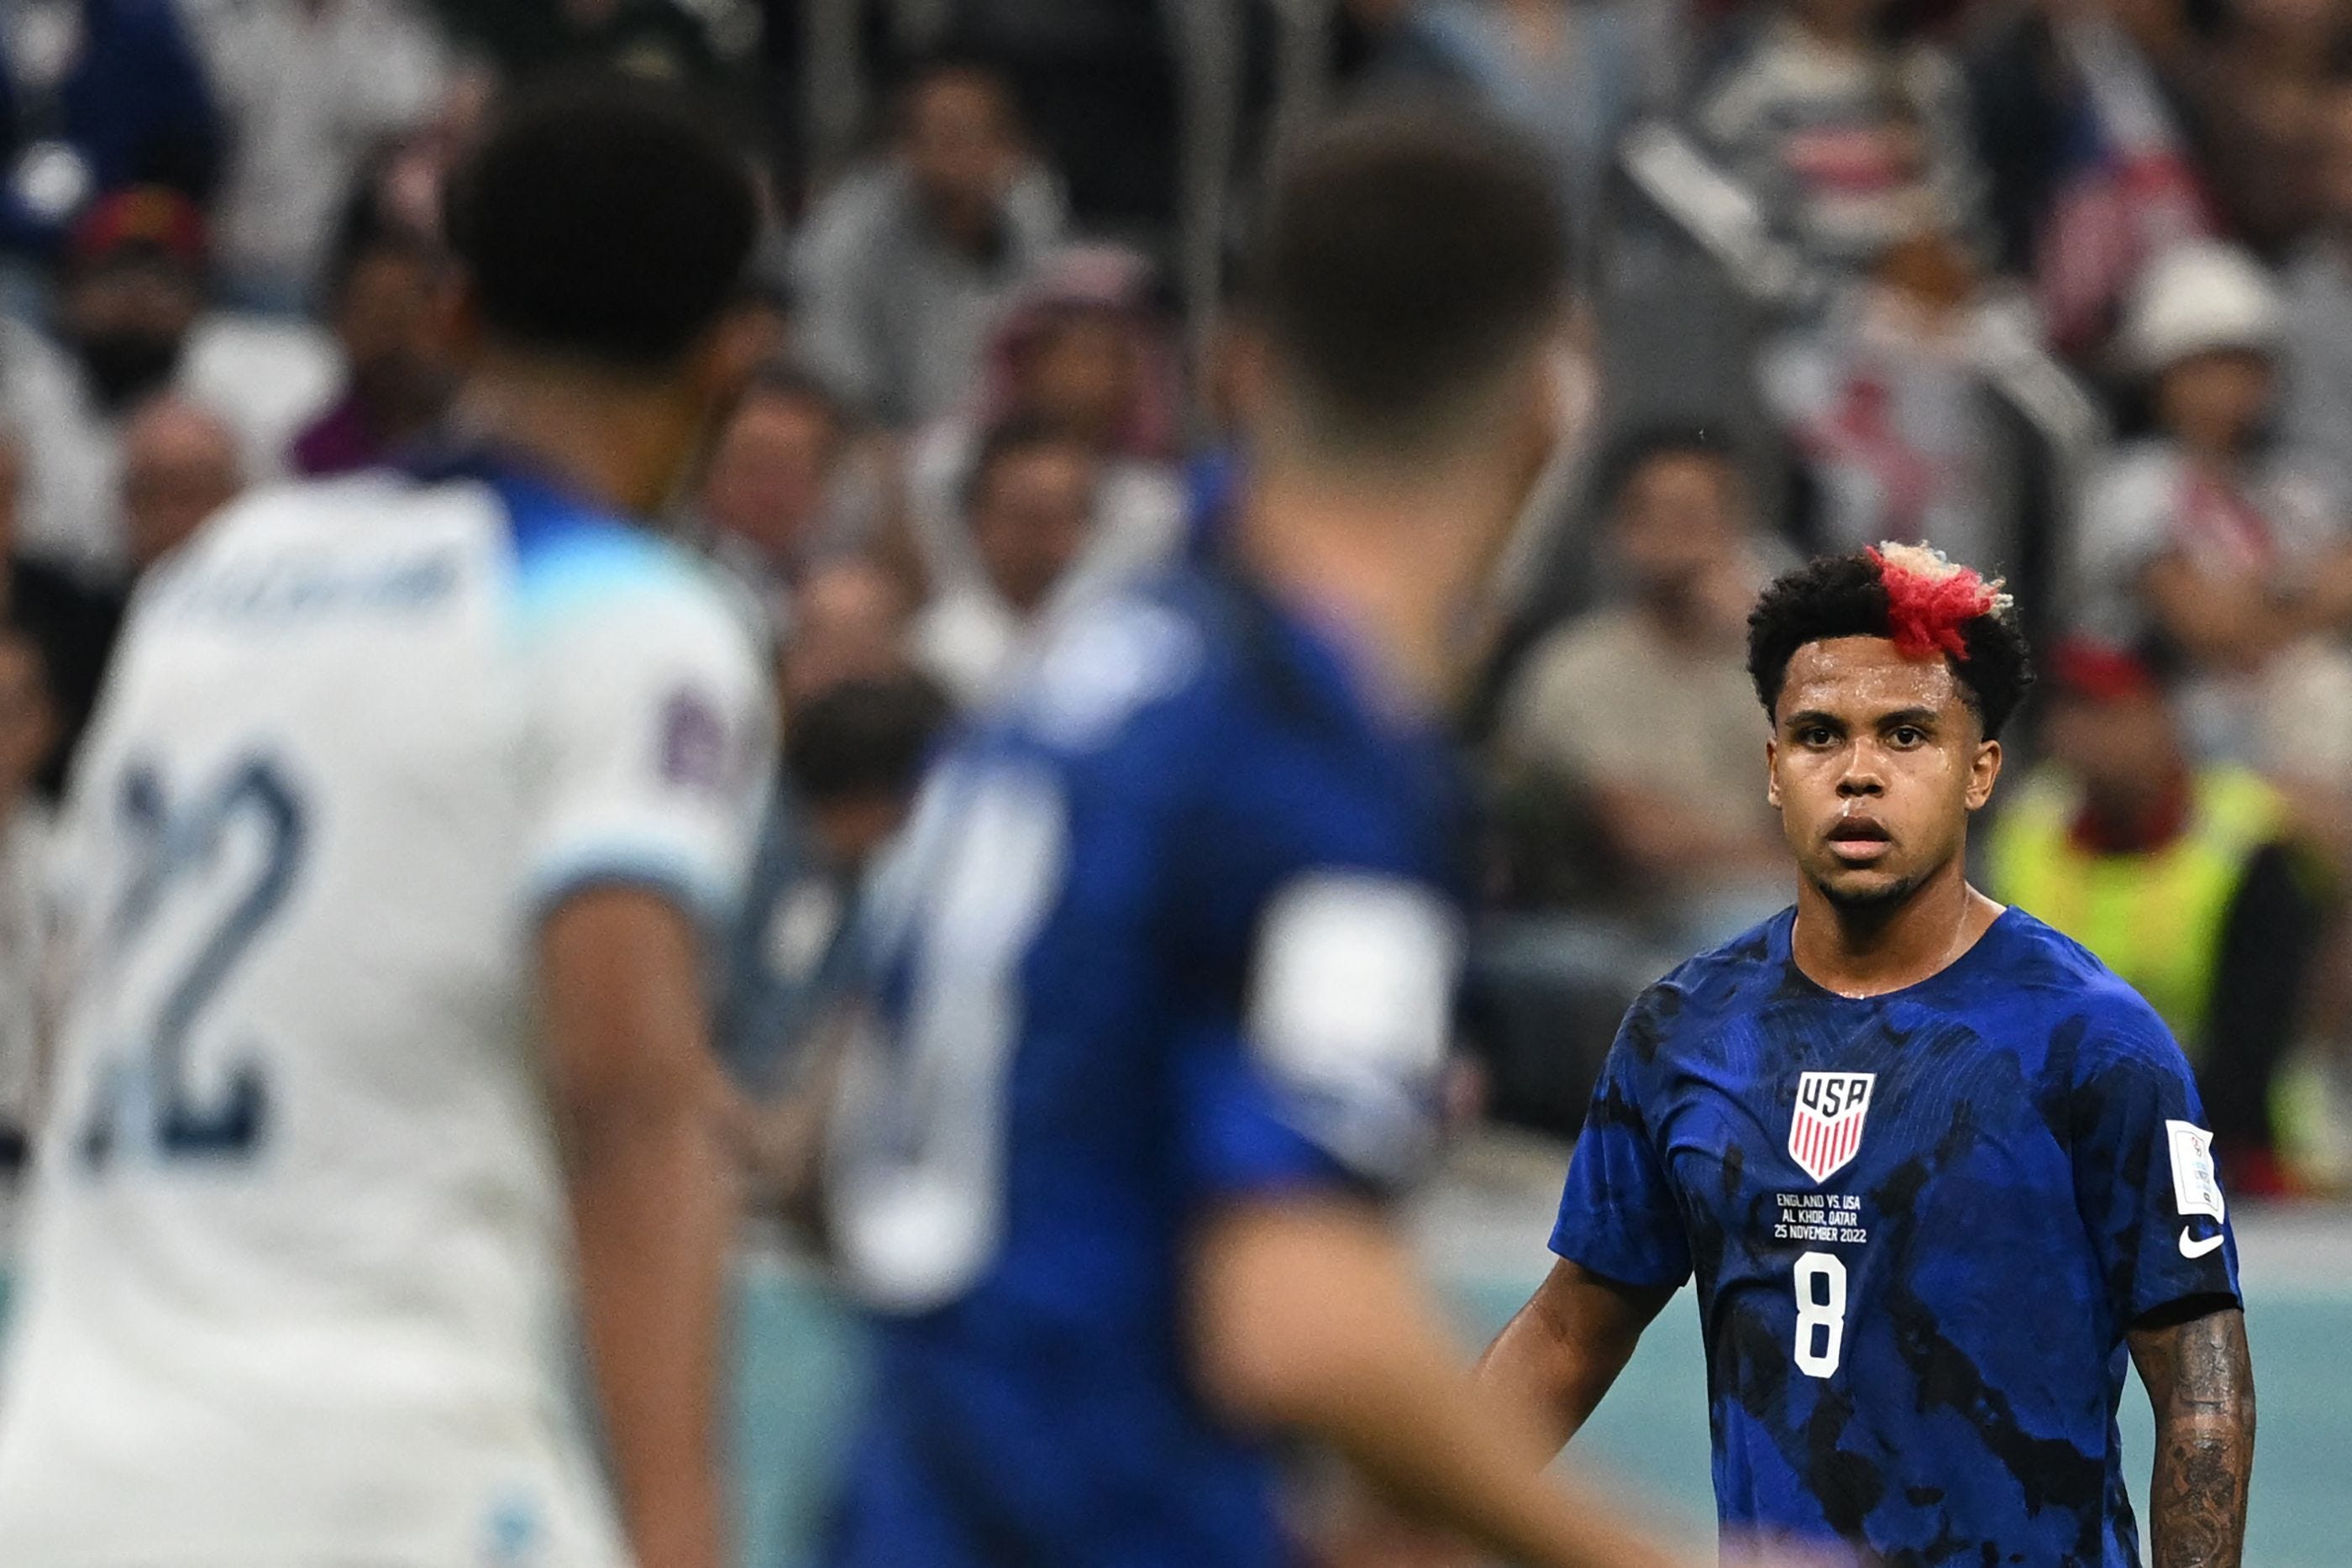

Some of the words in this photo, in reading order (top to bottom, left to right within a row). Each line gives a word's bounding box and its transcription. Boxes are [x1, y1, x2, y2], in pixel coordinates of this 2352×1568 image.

[1803, 1078, 1868, 1118] USA
[1777, 1193, 1824, 1208] ENGLAND
[1827, 1194, 1840, 1209] VS.
[1843, 1195, 1861, 1210] USA
[1782, 1209, 1796, 1223] AL
[1798, 1209, 1827, 1225] KHOR,
[1829, 1211, 1857, 1226] QATAR
[1774, 1224, 1788, 1238] 25
[1789, 1225, 1838, 1241] NOVEMBER
[1840, 1229, 1866, 1243] 2022
[1794, 1251, 1846, 1379] 8
